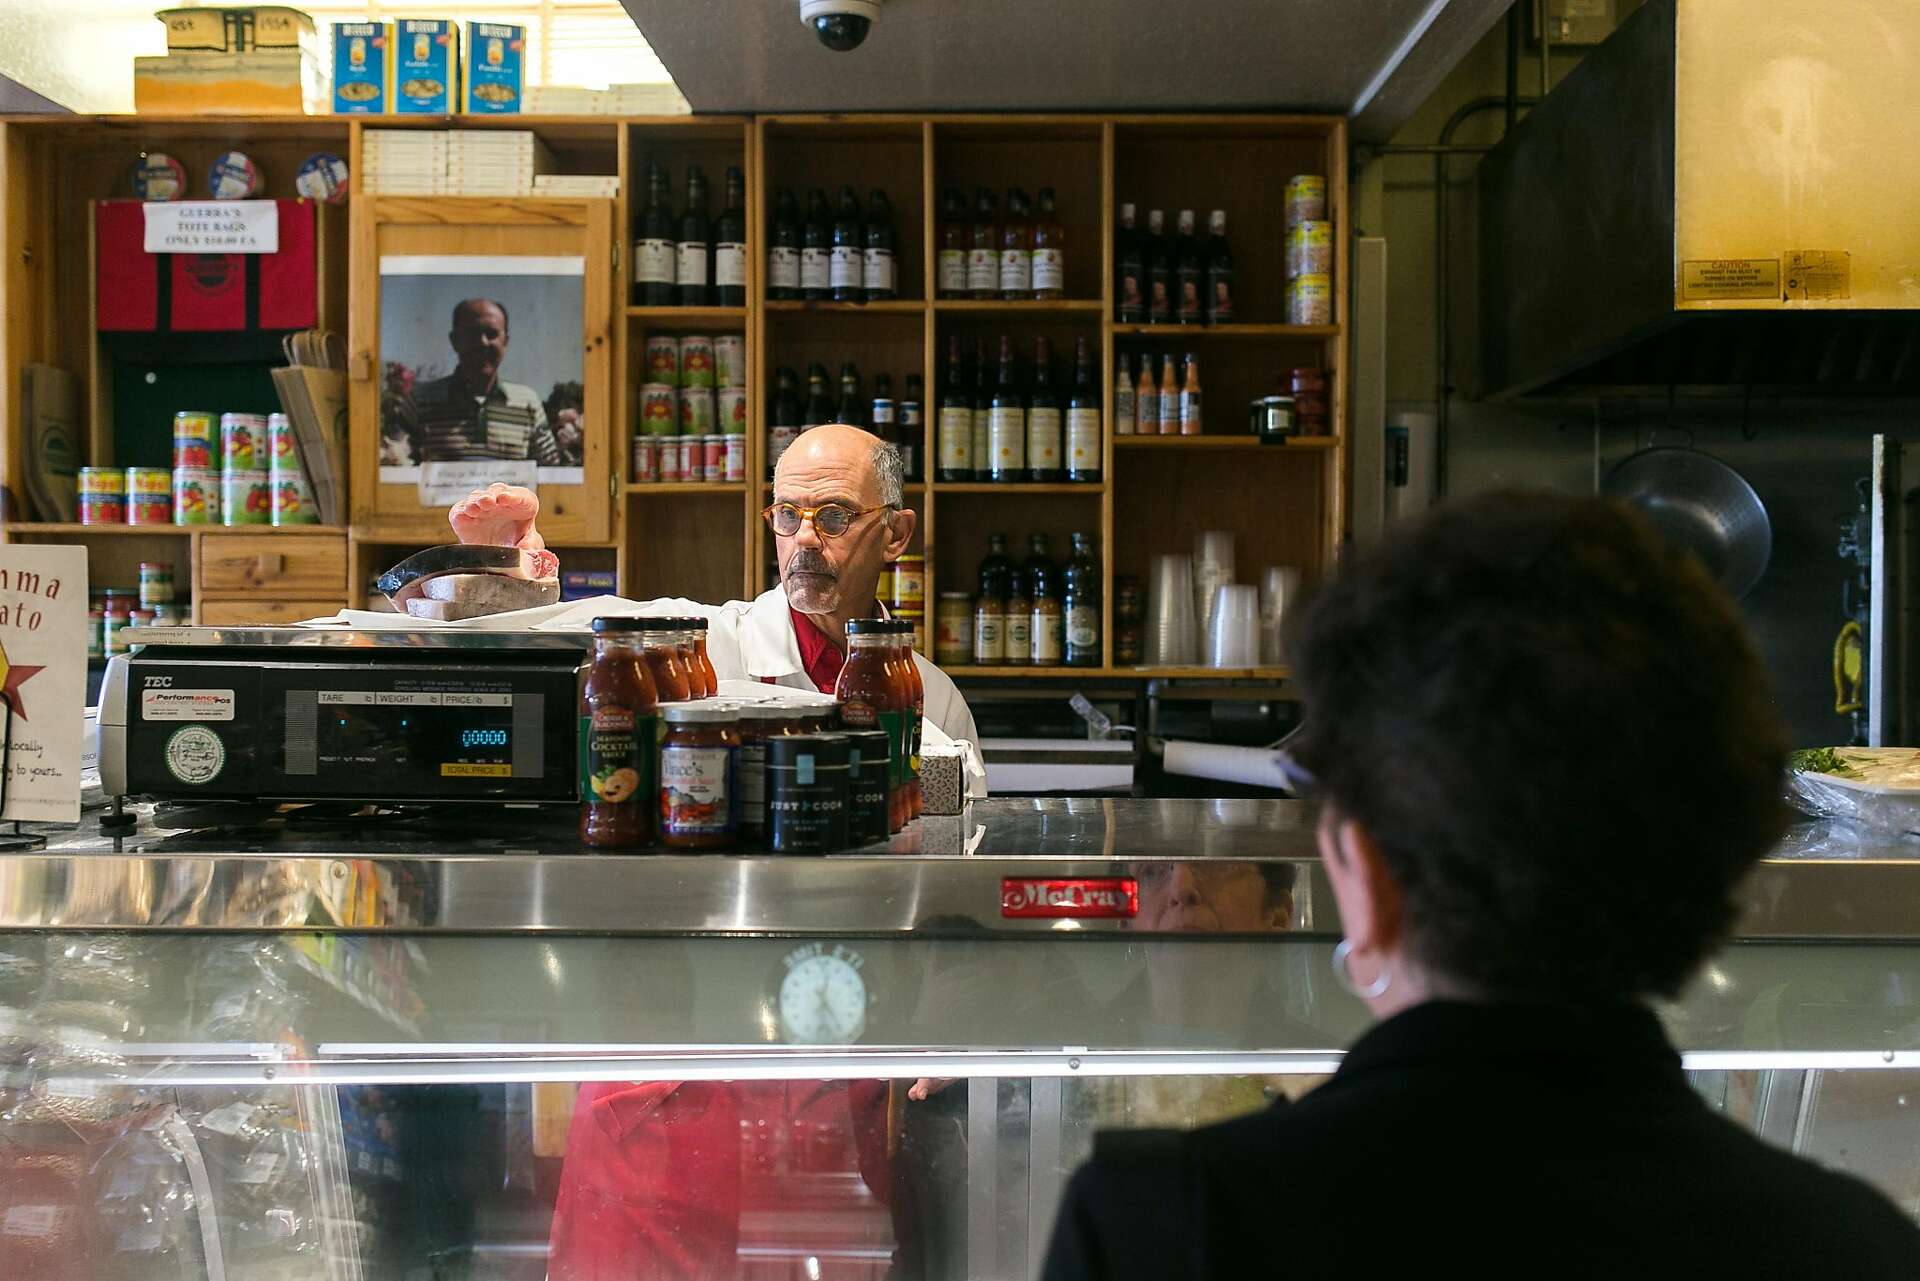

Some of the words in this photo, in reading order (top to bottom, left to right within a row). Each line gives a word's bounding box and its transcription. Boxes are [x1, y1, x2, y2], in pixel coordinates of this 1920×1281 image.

[1712, 260, 1750, 269] CAUTION
[144, 676, 173, 688] TEC
[156, 694, 219, 702] Performance
[322, 694, 344, 702] TARE
[380, 695, 414, 703] WEIGHT
[17, 763, 26, 775] to
[448, 766, 470, 774] TOTAL
[471, 766, 496, 775] PRICE
[770, 800, 800, 811] JUST
[1003, 883, 1132, 911] McCray
